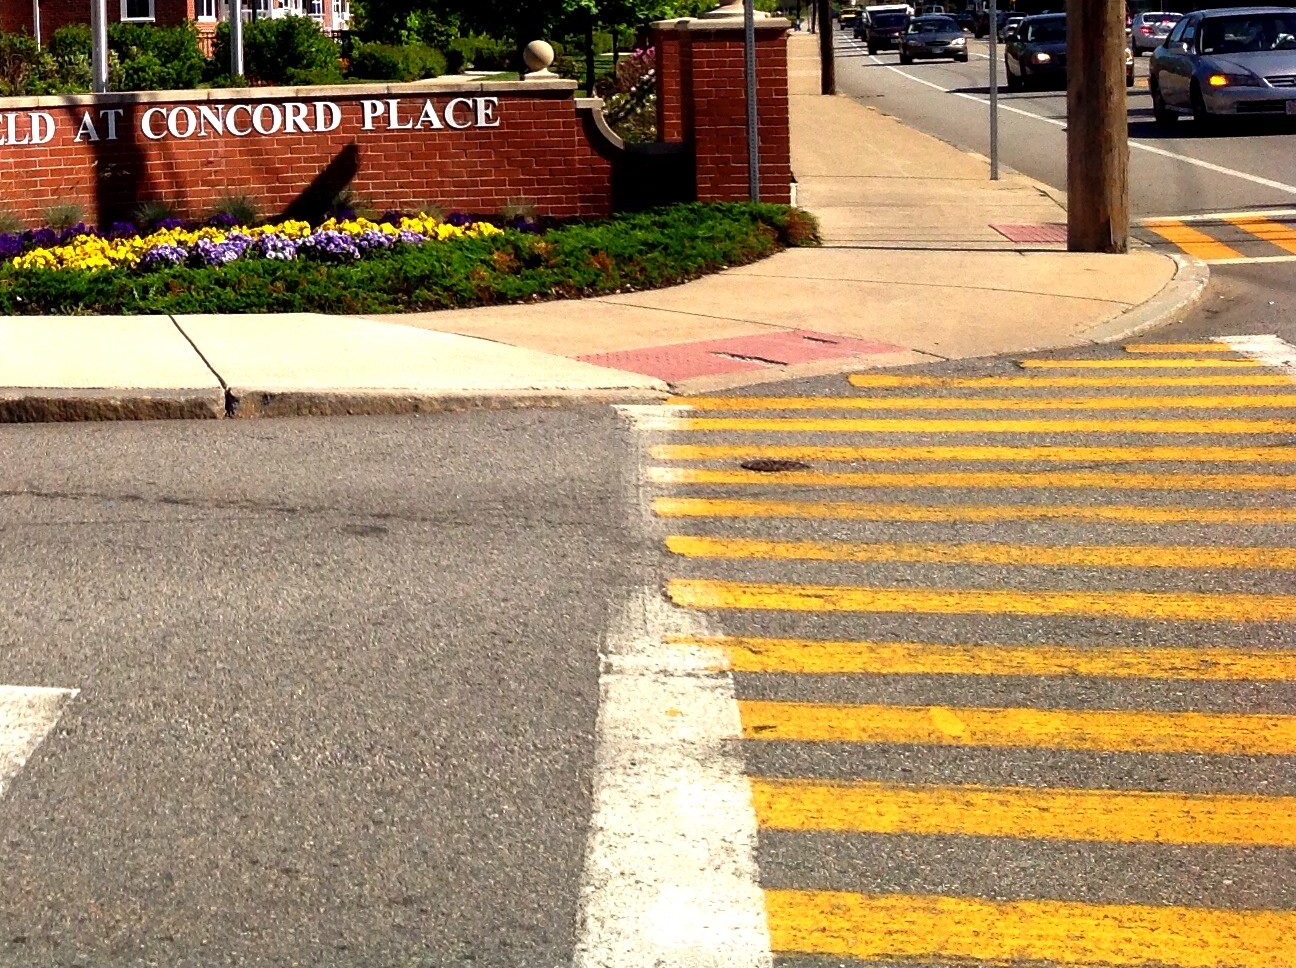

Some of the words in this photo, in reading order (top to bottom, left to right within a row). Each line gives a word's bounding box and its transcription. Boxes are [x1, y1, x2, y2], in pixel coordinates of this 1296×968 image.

[74, 109, 124, 142] AT
[140, 101, 342, 140] CONCORD
[361, 97, 500, 131] PLACE
